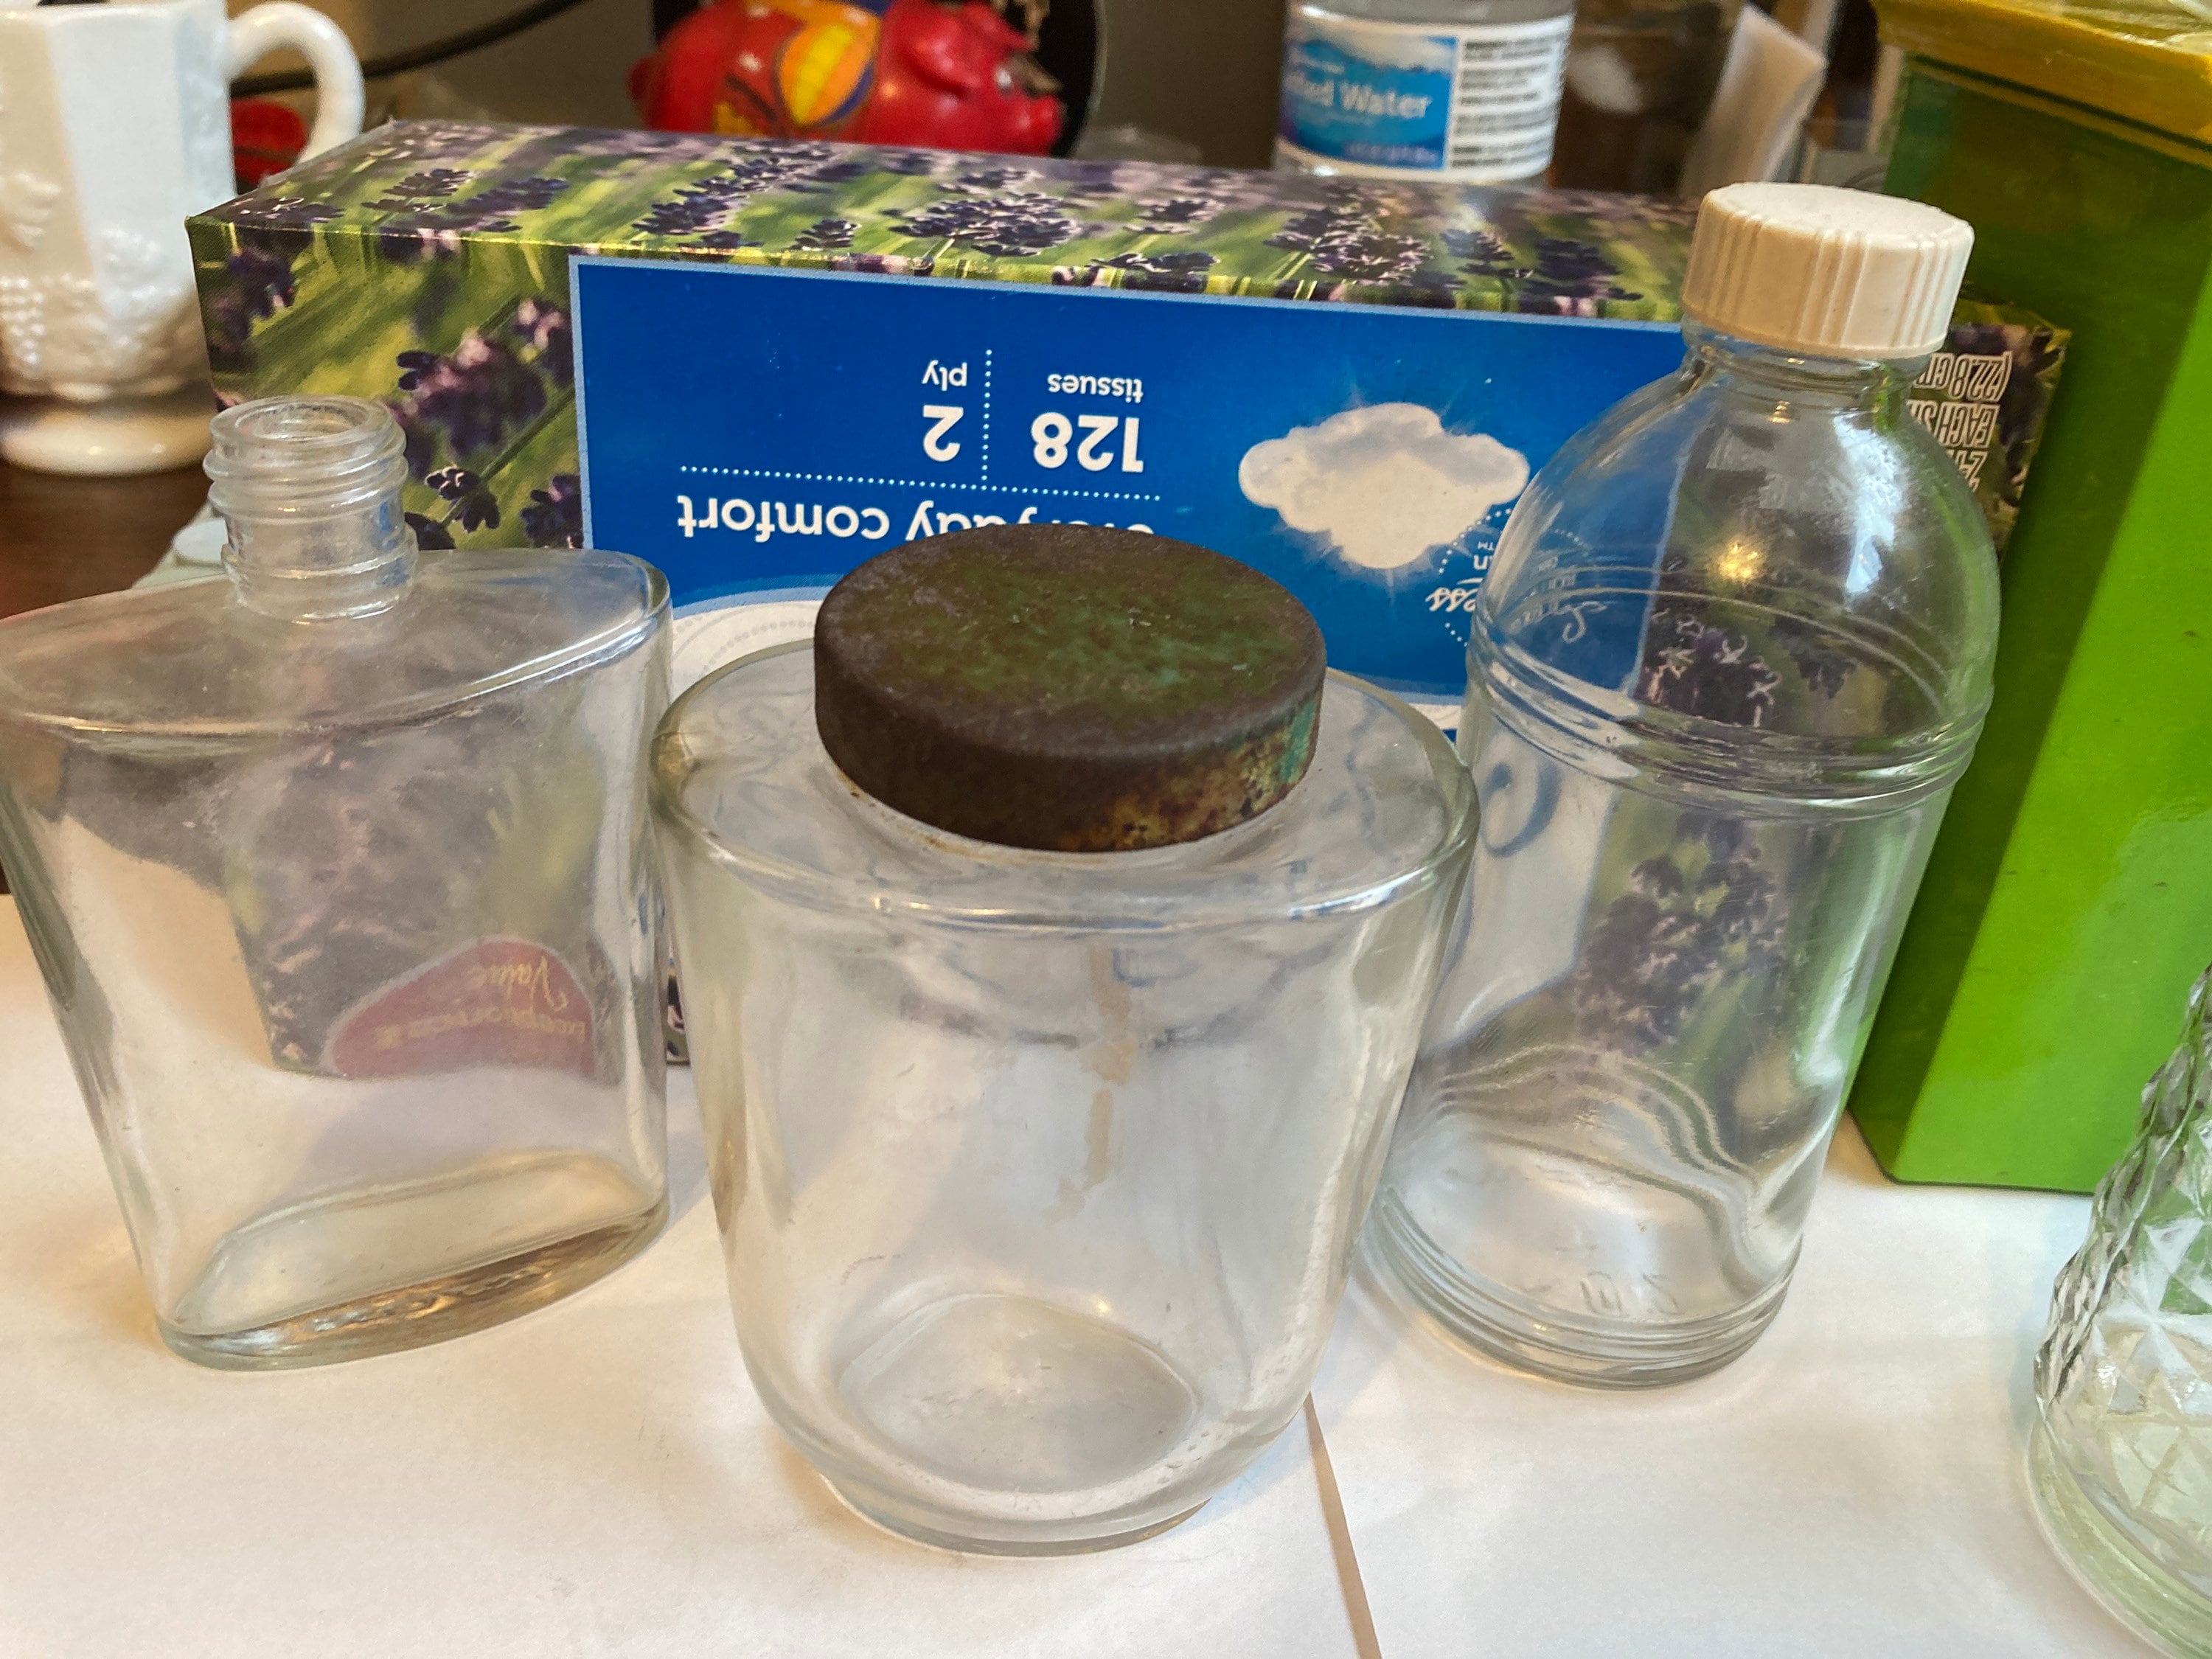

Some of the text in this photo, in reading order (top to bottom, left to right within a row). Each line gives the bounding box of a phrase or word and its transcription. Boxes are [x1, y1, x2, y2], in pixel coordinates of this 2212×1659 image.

[1340, 81, 1433, 119] Water
[922, 361, 967, 392] ply
[1047, 373, 1143, 403] tissues
[922, 404, 964, 462] 2
[1031, 411, 1144, 473] 128
[1935, 402, 2000, 448] EACH
[677, 495, 890, 543] comfort
